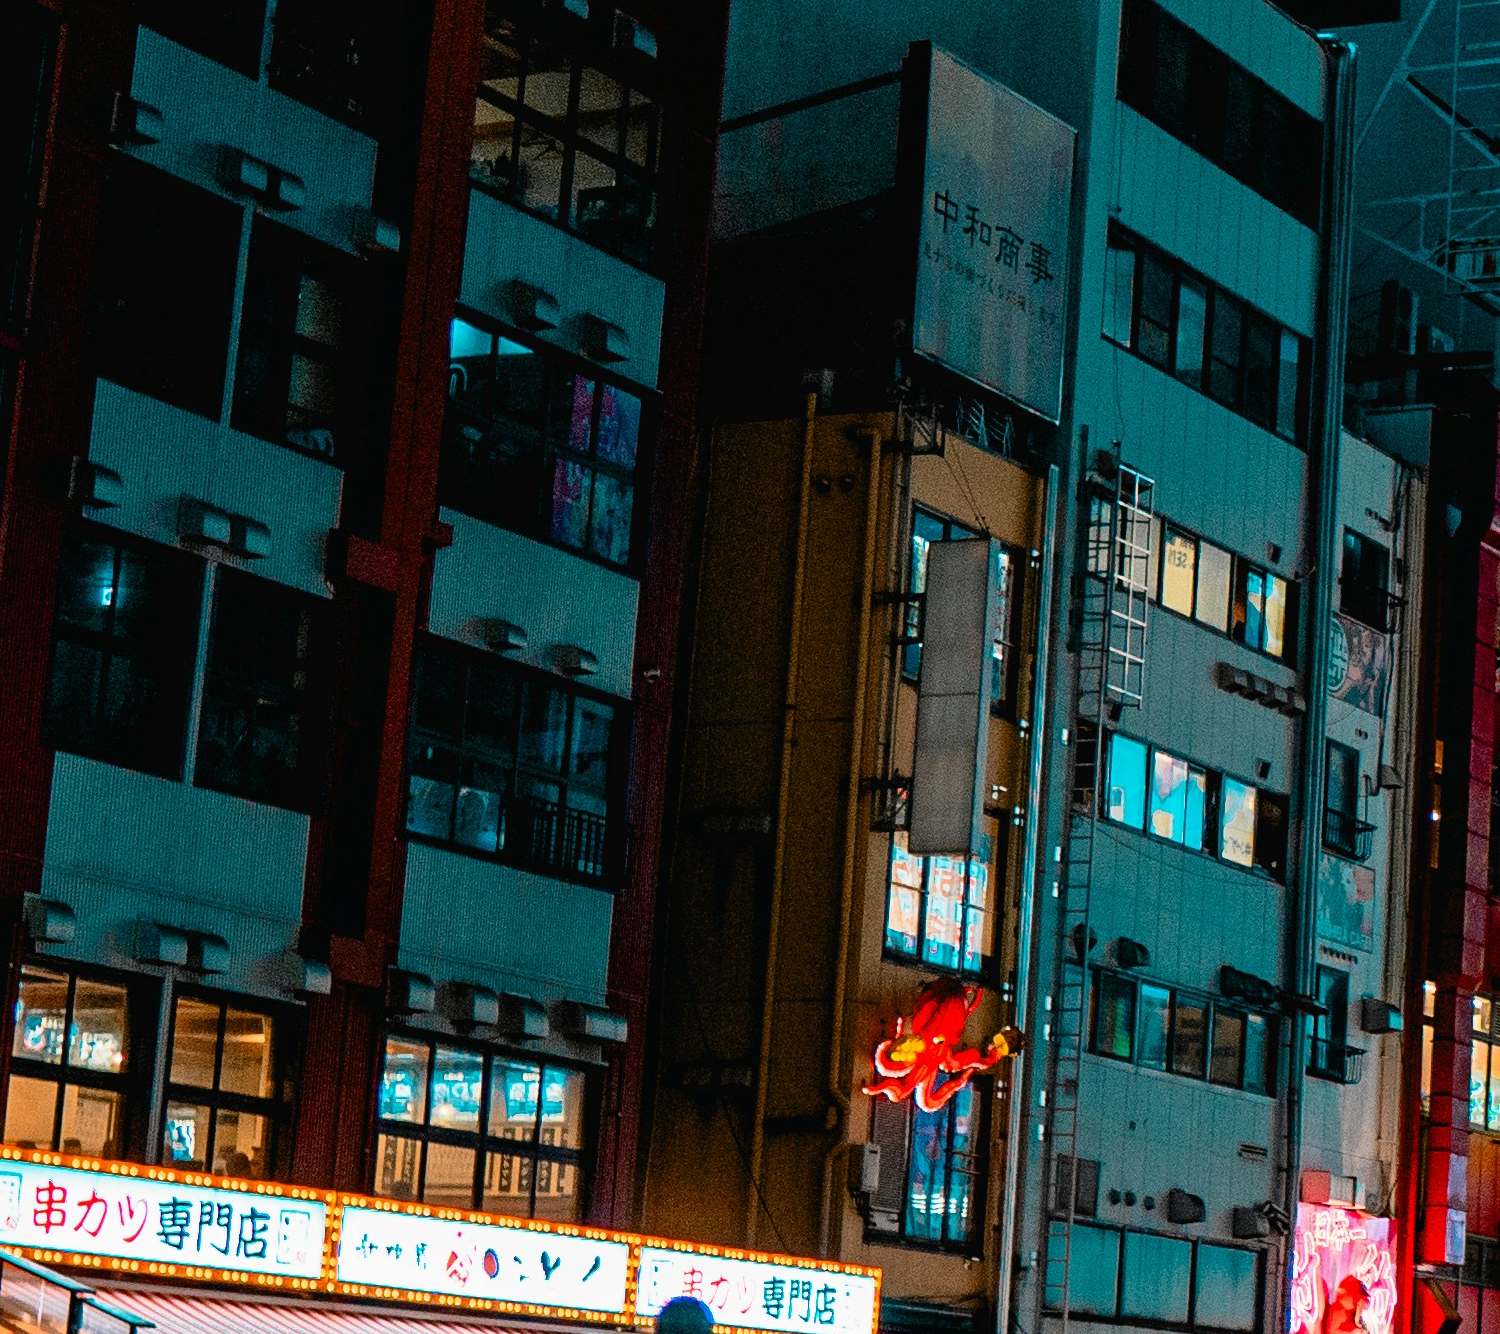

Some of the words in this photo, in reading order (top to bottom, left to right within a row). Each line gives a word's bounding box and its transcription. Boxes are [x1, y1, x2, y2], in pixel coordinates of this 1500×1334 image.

[933, 188, 1054, 285] 中和商事
[33, 1178, 272, 1260] 串カツ専門店
[1313, 1210, 1367, 1252] 日本一
[680, 1265, 839, 1326] 串カツ専門店
